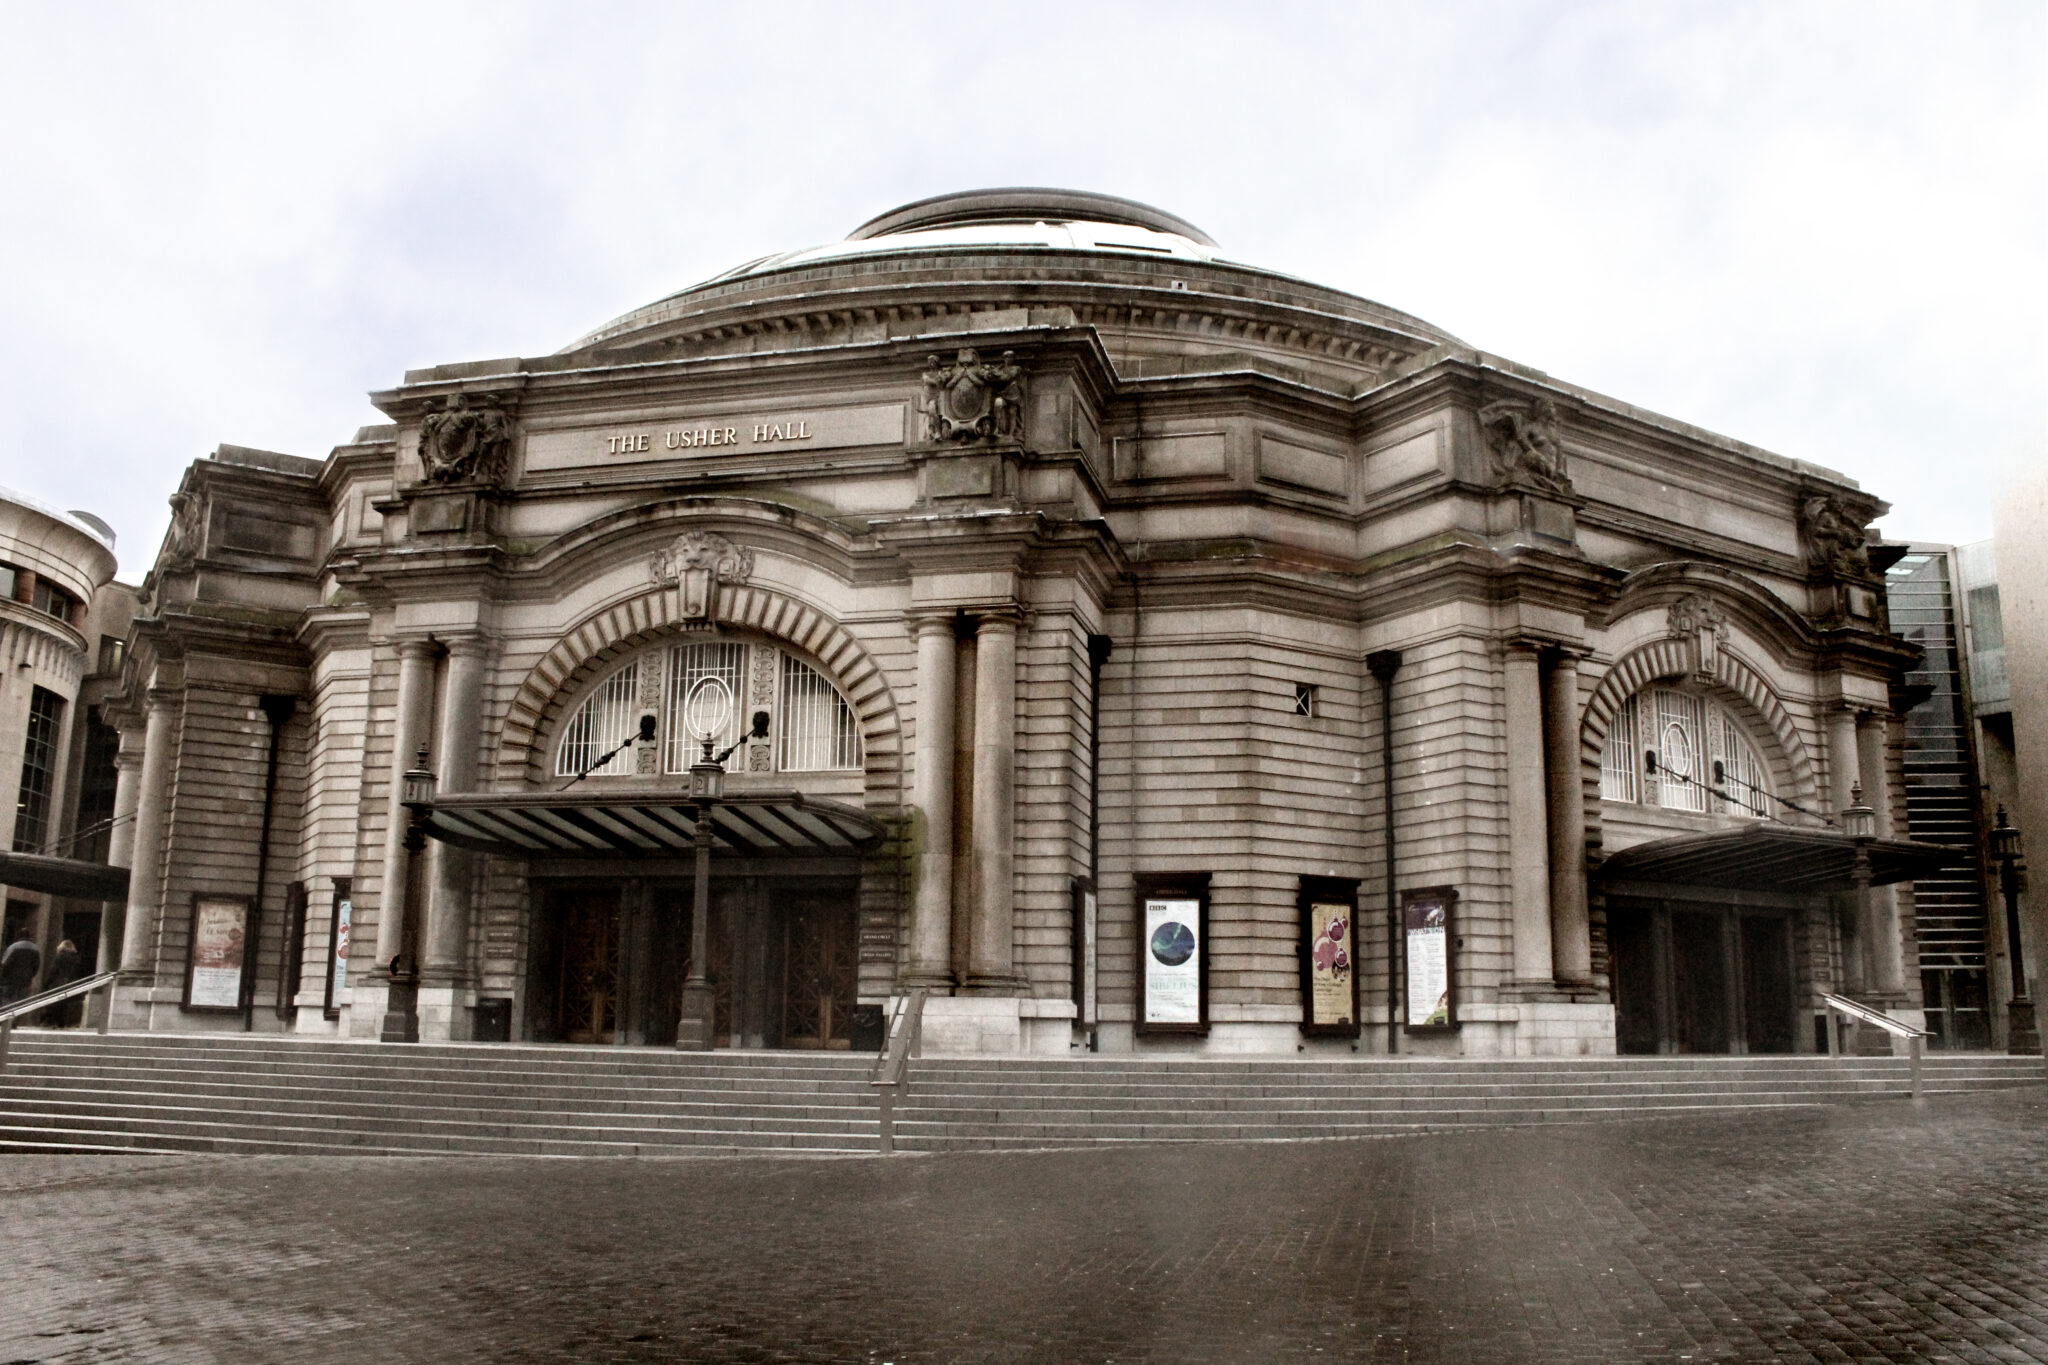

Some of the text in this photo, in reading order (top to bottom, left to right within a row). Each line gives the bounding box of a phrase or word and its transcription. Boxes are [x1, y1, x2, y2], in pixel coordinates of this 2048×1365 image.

[608, 421, 812, 455] THE USHER HALL
[696, 779, 704, 790] 2
